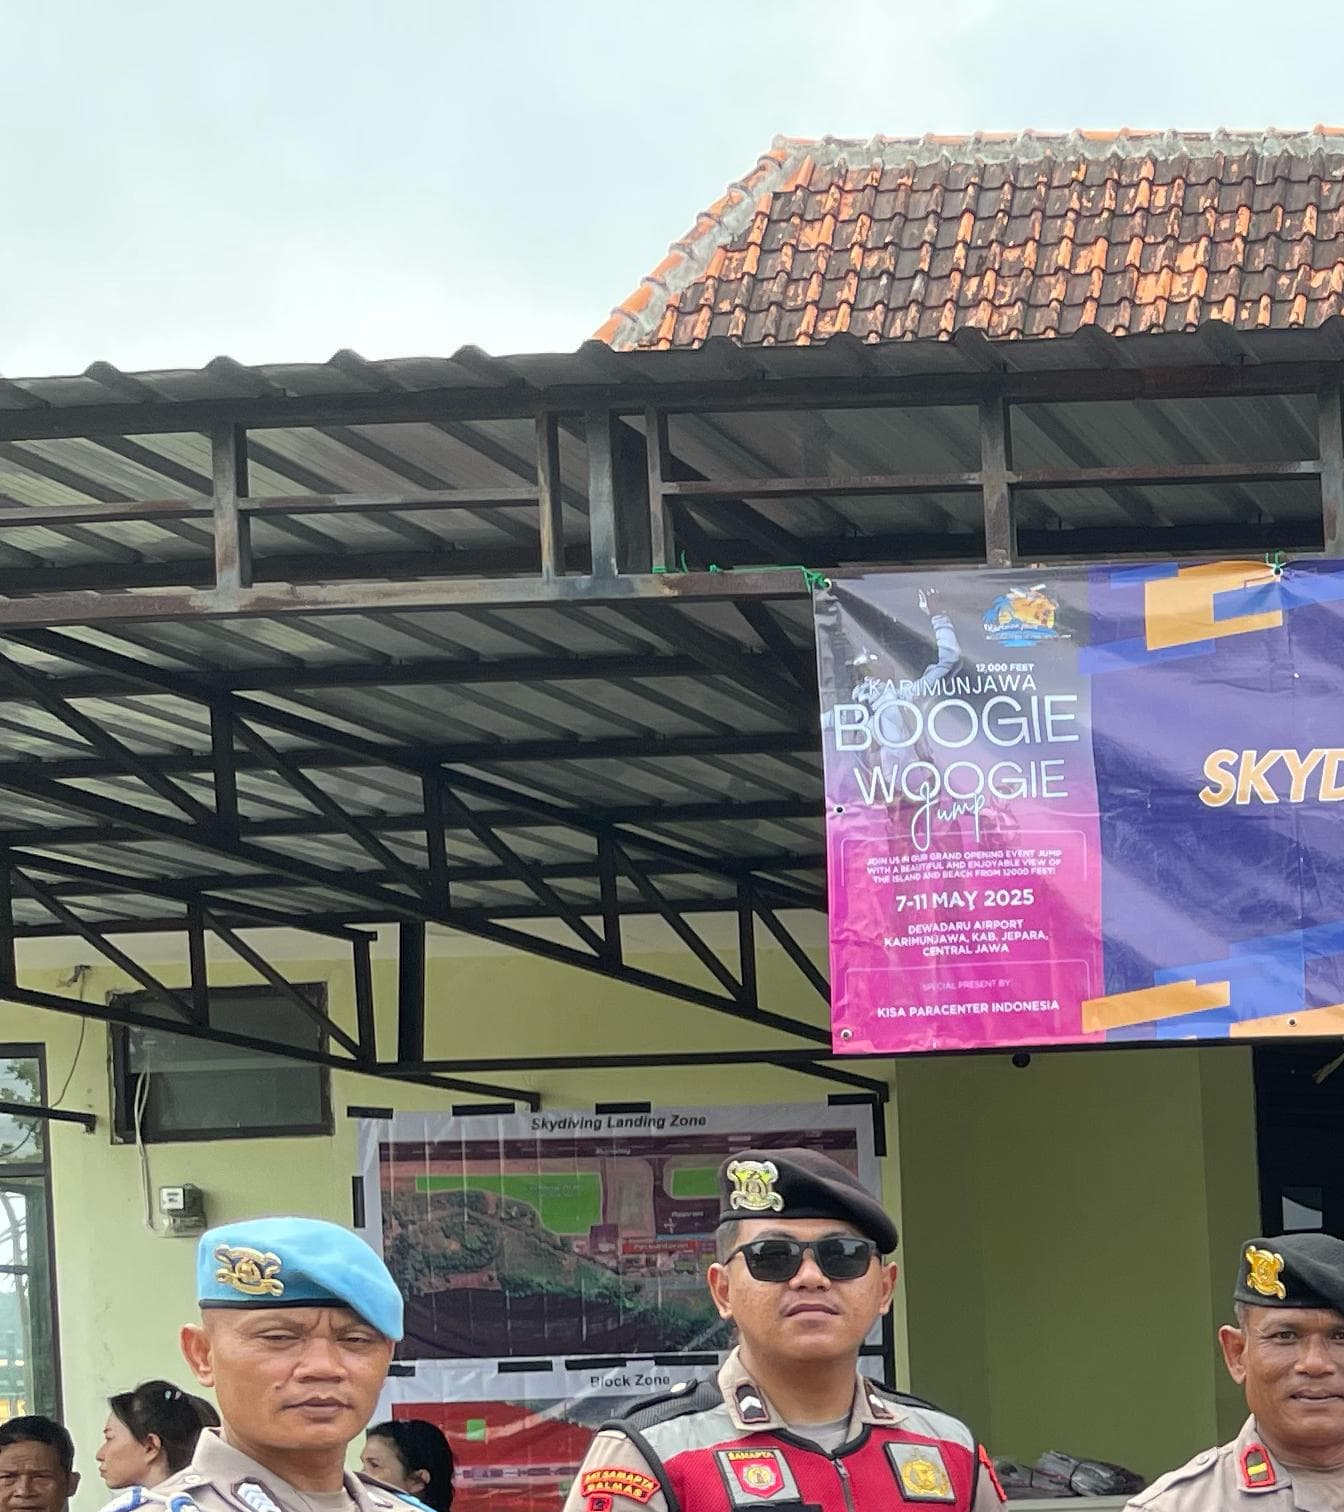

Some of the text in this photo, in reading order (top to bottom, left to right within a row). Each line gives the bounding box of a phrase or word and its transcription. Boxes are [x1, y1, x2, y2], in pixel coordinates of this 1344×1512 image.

[975, 662, 1035, 674] 12,000 FEET
[868, 673, 1037, 697] KARIMUNJAWA
[832, 694, 1080, 753] BOOGIE
[853, 758, 1069, 806] WOOGIE
[866, 865, 891, 876] WITH
[900, 861, 945, 873] BEAUTIFUL
[946, 860, 966, 870] AND
[967, 859, 1020, 869] ENJOYABLE
[1048, 857, 1063, 867] OF
[889, 855, 900, 865] US
[929, 851, 962, 862] GRAND
[963, 850, 1004, 860] OPENING
[1005, 849, 1035, 859] EVENT
[872, 874, 890, 884] THE
[892, 873, 922, 883] ISLAND
[922, 871, 940, 880] AND
[974, 868, 1001, 878] FROM
[895, 888, 1035, 912] 7-11 MAY 2025
[908, 918, 1025, 935] DEWADARU AIRPORT
[884, 929, 1049, 948] KARIMUNJAWA, KAB. JEPARA,
[922, 942, 1010, 957] CENTRAL JAWA
[877, 999, 1060, 1019] KISA PARACENTER INDONESIA
[530, 1113, 707, 1133] Skydiving Landing Zone
[590, 1373, 671, 1388] Block Zone
[727, 1450, 776, 1461] SAMAPTA
